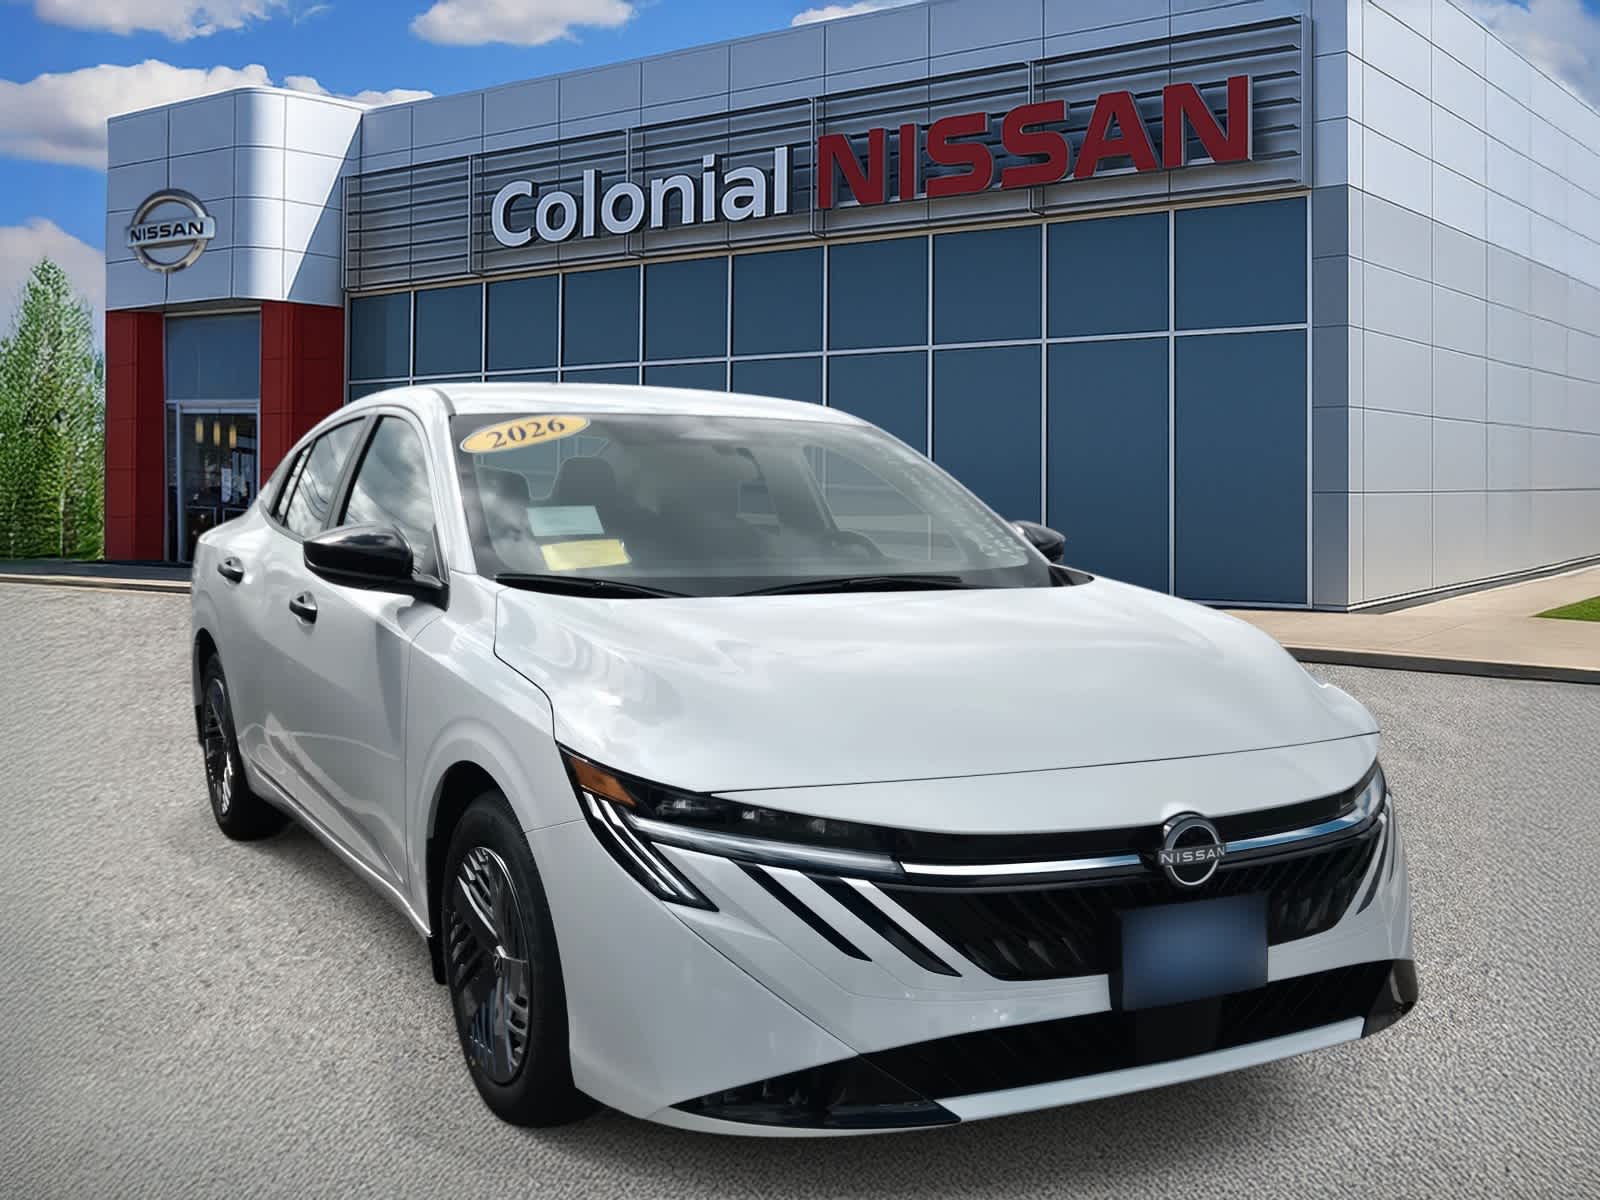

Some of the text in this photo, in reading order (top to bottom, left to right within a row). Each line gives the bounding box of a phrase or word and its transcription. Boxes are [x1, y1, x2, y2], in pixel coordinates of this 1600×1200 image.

[491, 75, 1252, 248] Colonial NISSAN
[130, 221, 204, 242] NISSAN
[487, 417, 565, 449] 2026
[1160, 846, 1225, 864] NISSAN
